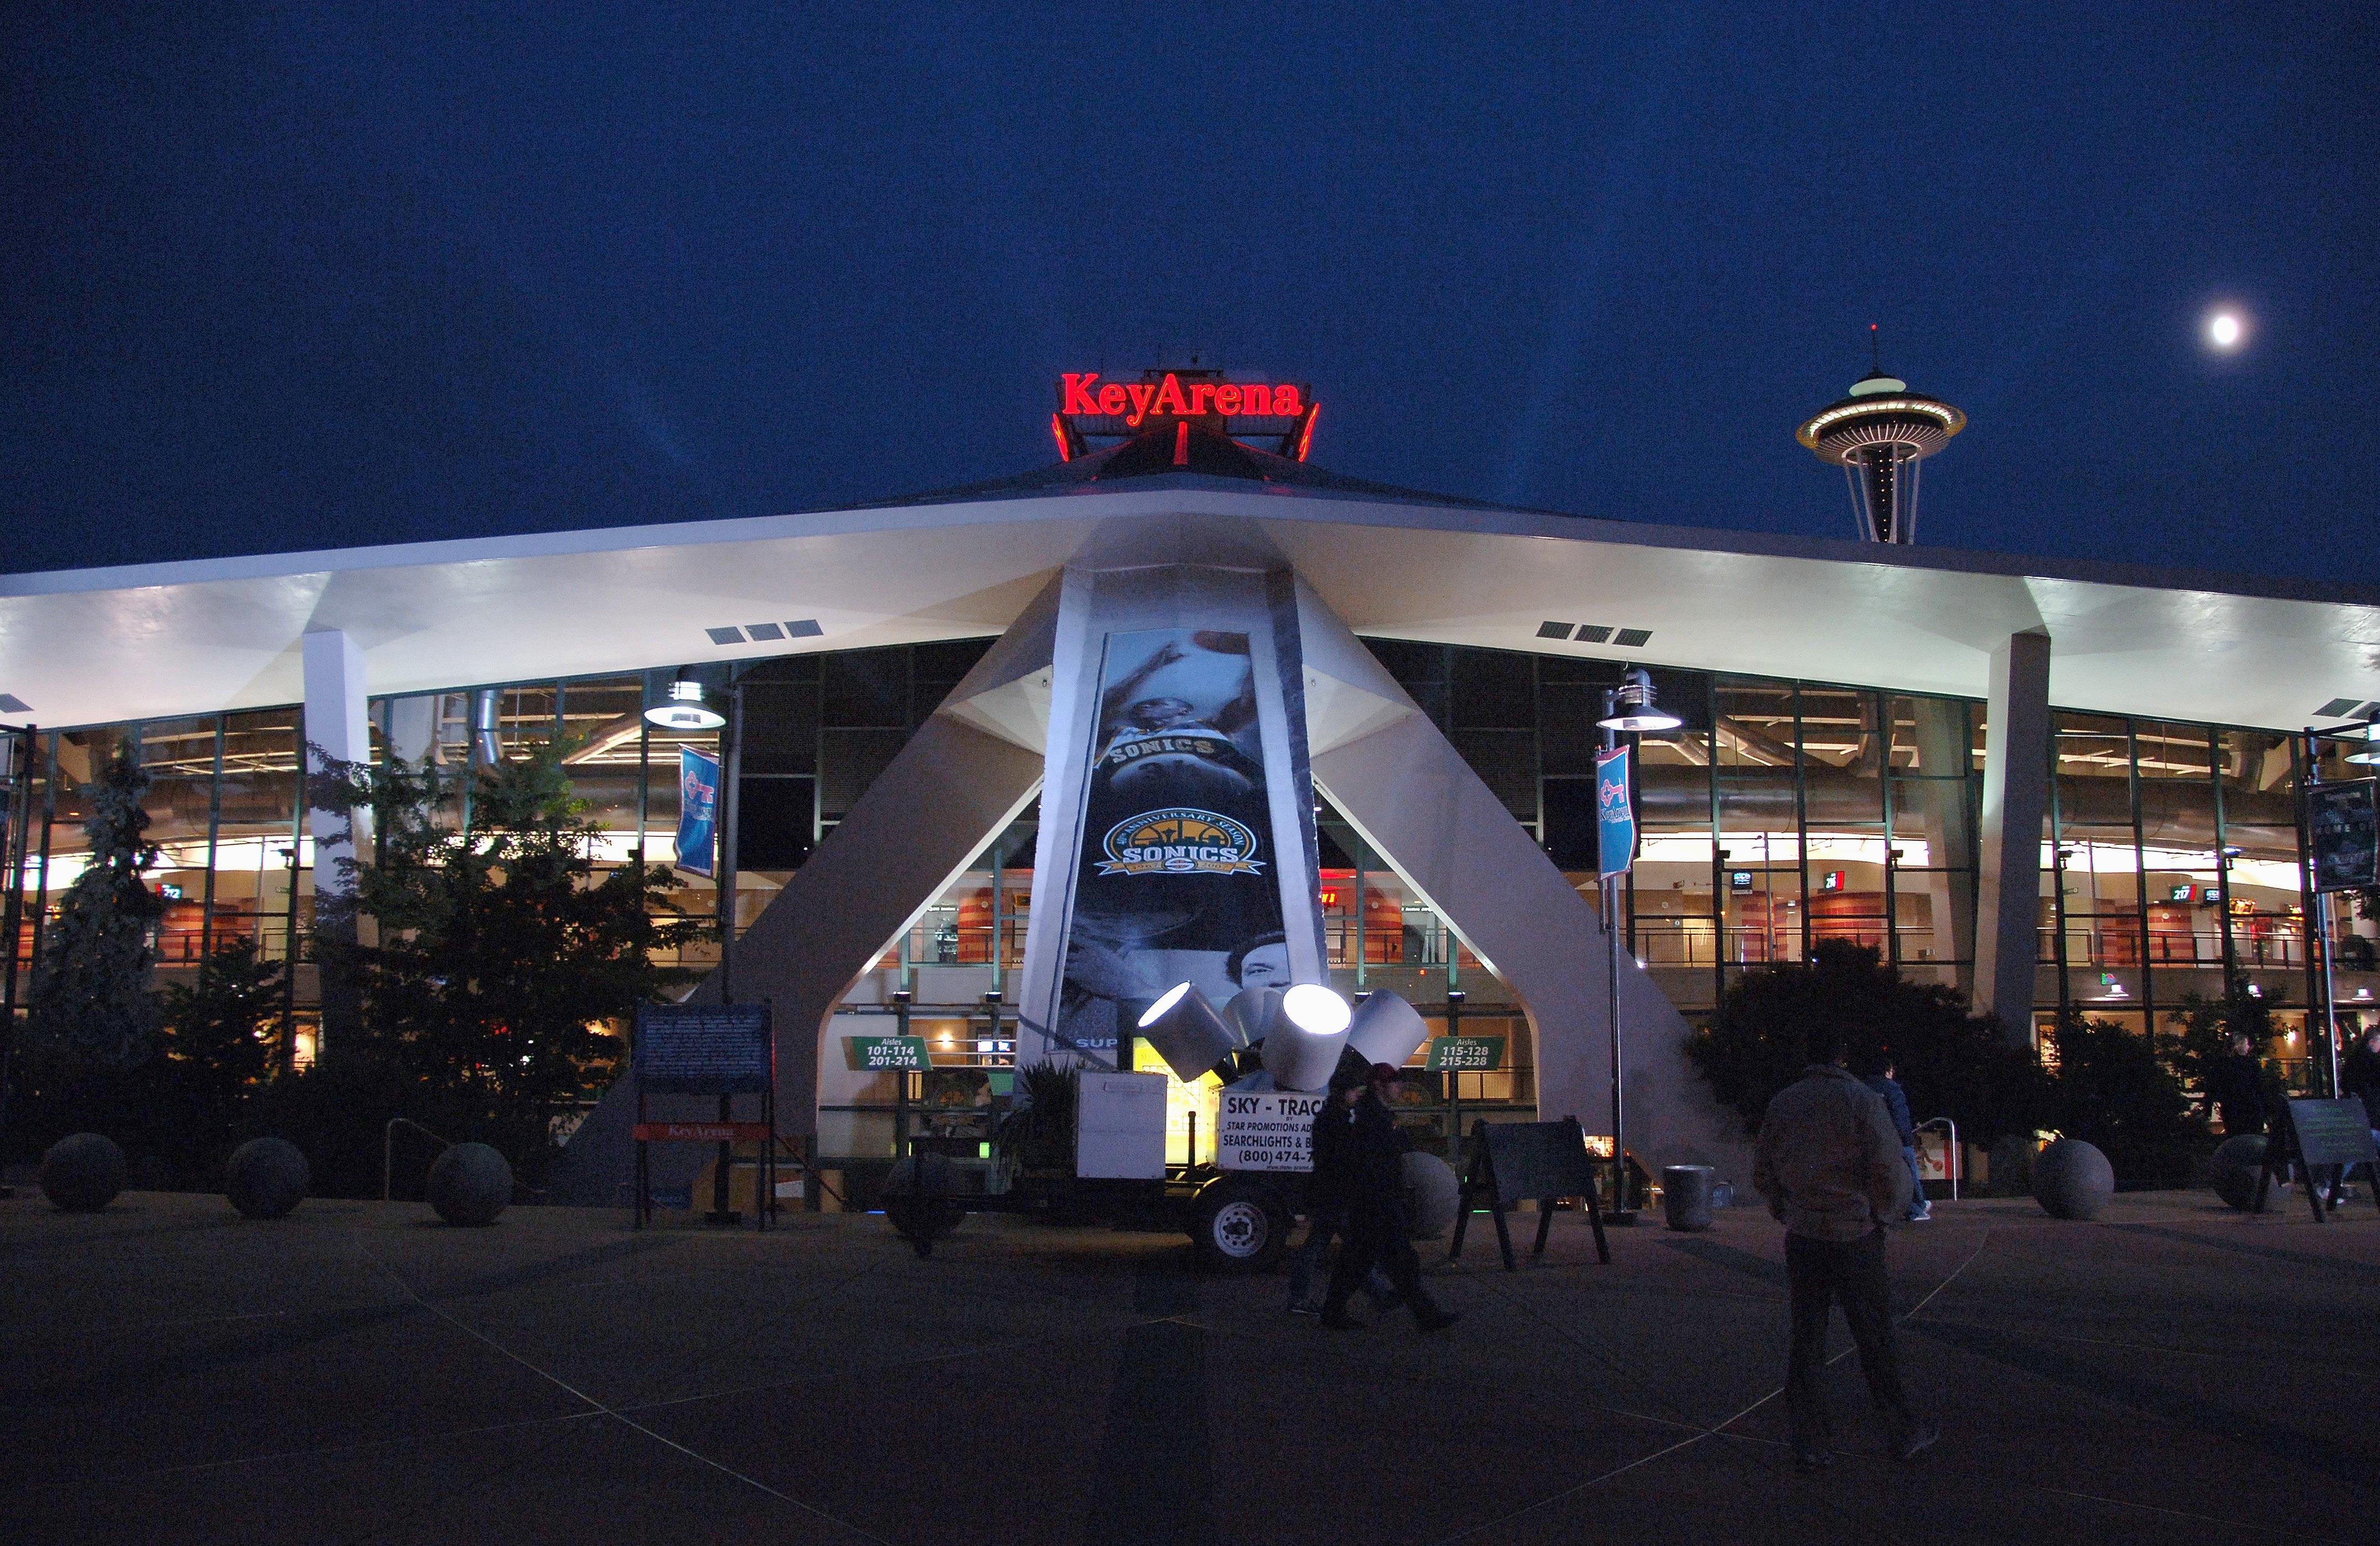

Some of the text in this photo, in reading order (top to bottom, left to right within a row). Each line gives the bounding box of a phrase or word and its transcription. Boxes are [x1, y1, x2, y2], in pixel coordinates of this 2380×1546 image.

[1062, 373, 1302, 427] KeyArena
[1110, 739, 1215, 763] SONICS
[1125, 813, 1214, 833] ANNIVERSARY
[1217, 821, 1245, 846] SEASON
[1122, 845, 1239, 863] SONICS
[867, 1046, 915, 1055] 101-114
[1443, 1047, 1489, 1055] 115-128
[868, 1056, 917, 1065] 201-214
[1439, 1056, 1487, 1065] 215-228
[1228, 1097, 1260, 1114] SKY
[1227, 1122, 1244, 1130] STAR
[1247, 1122, 1299, 1132] PROMOTIONS
[1223, 1134, 1313, 1149] SEARCHLIGHTS & B
